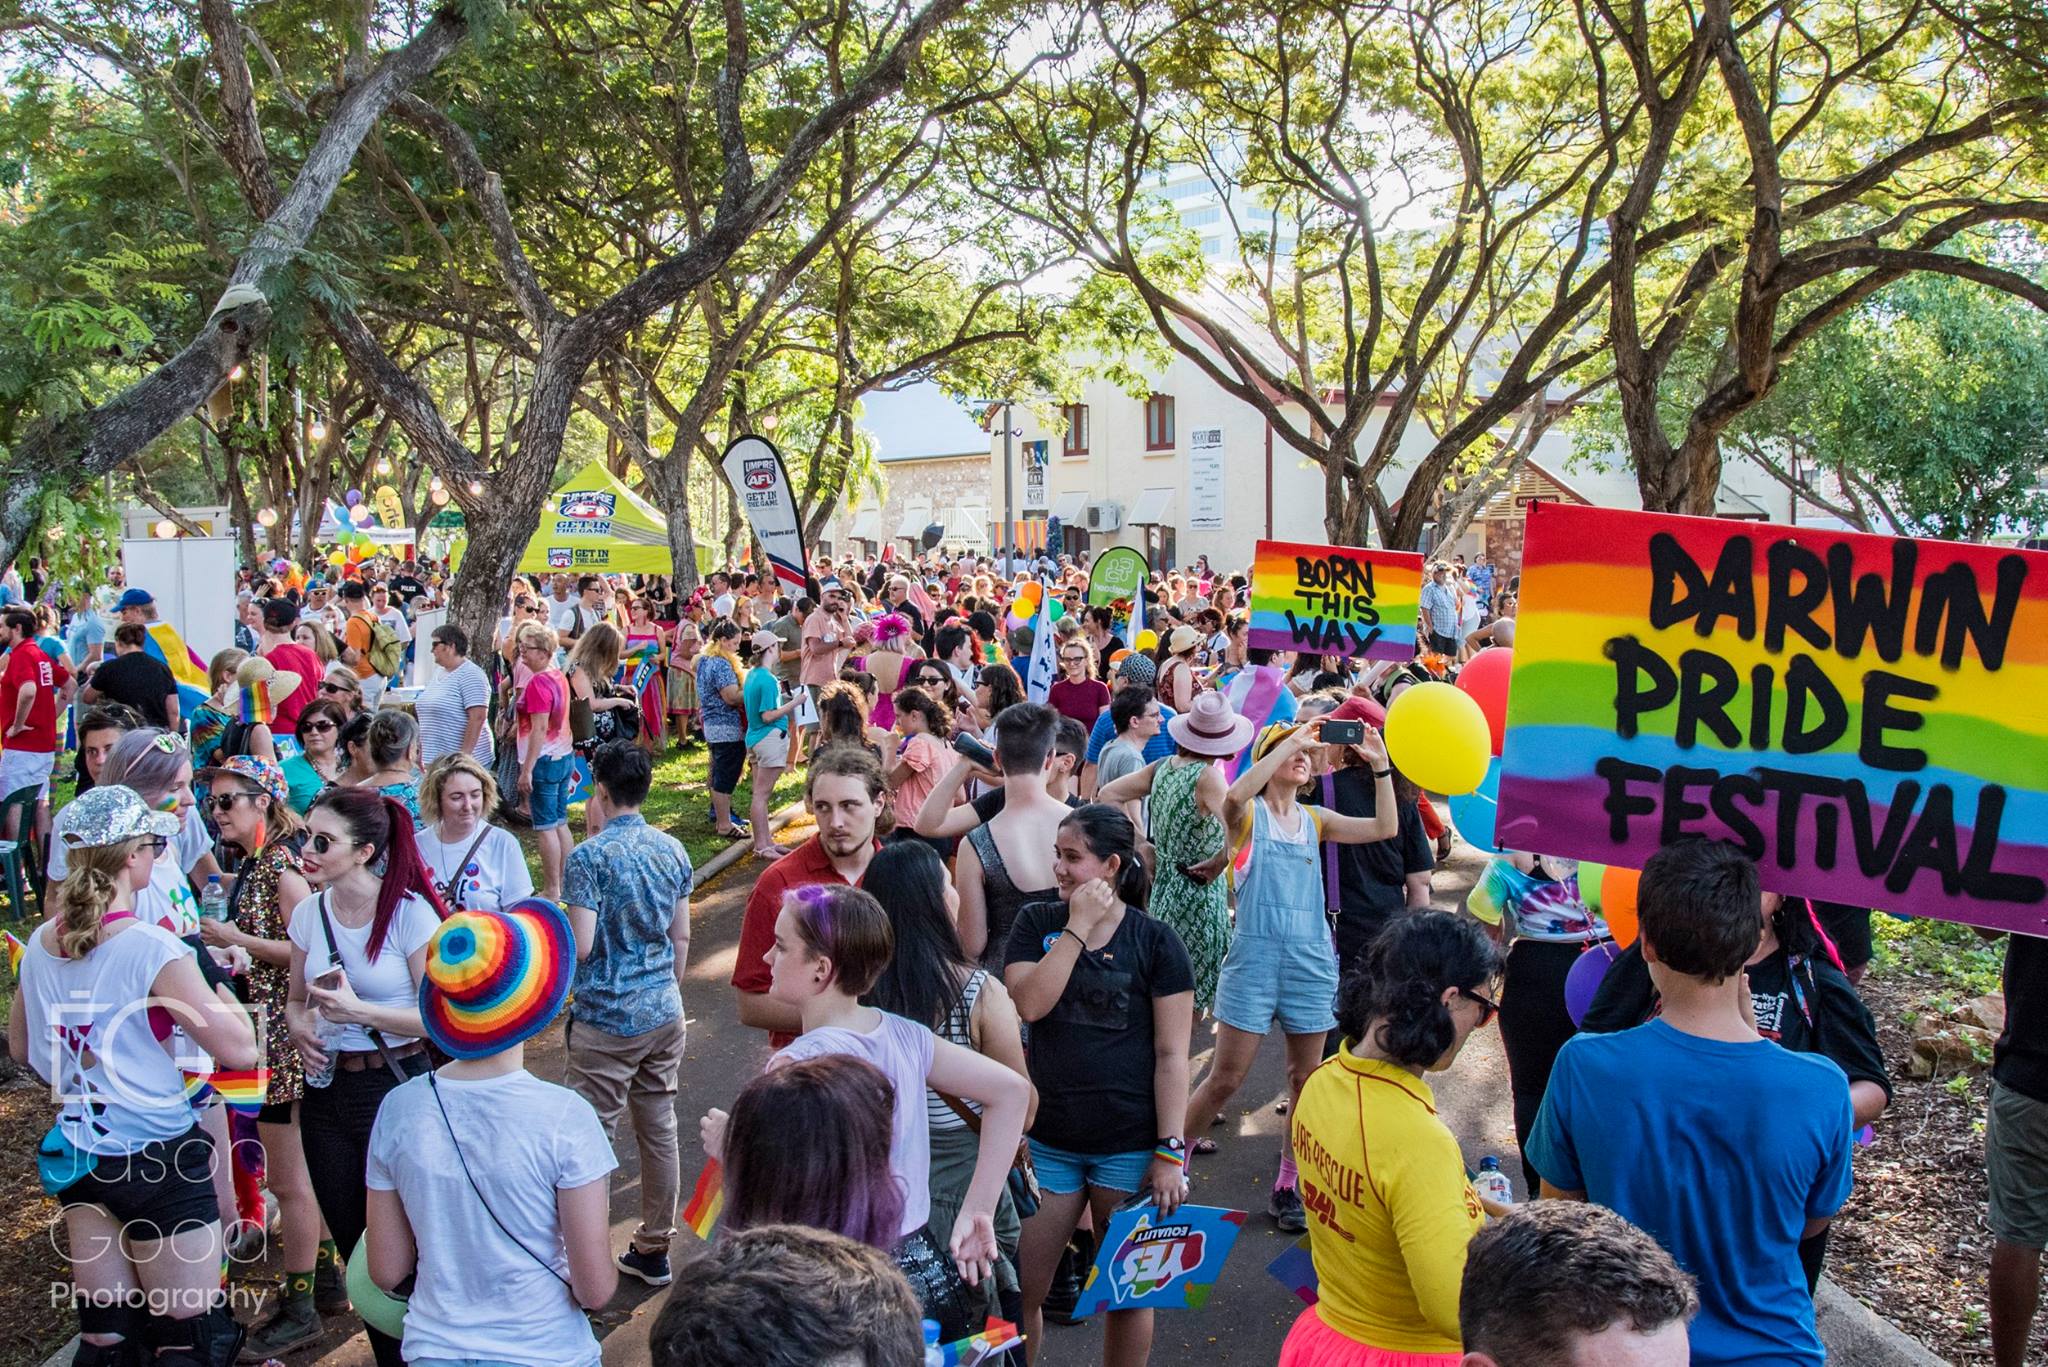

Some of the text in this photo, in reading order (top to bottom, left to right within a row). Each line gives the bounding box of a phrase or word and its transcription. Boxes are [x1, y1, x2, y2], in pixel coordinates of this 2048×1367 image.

[745, 460, 775, 472] UMPIRE
[748, 473, 774, 486] AFL
[746, 491, 777, 501] GET IN
[566, 504, 610, 516] AFL
[556, 520, 610, 529] GET IN
[551, 557, 570, 566] AFL
[575, 549, 609, 558] GET IN
[1295, 554, 1376, 599] BORN
[1294, 590, 1380, 626] THIS
[1649, 532, 2027, 671] DARWIN
[1284, 609, 1383, 657] WAY
[1604, 634, 1941, 771] PRIDE
[1595, 756, 2047, 903] FESTIVAL
[1313, 1140, 1366, 1209] RESCUE
[1135, 1226, 1189, 1243] EQUALITY
[1118, 1243, 1186, 1286] YES
